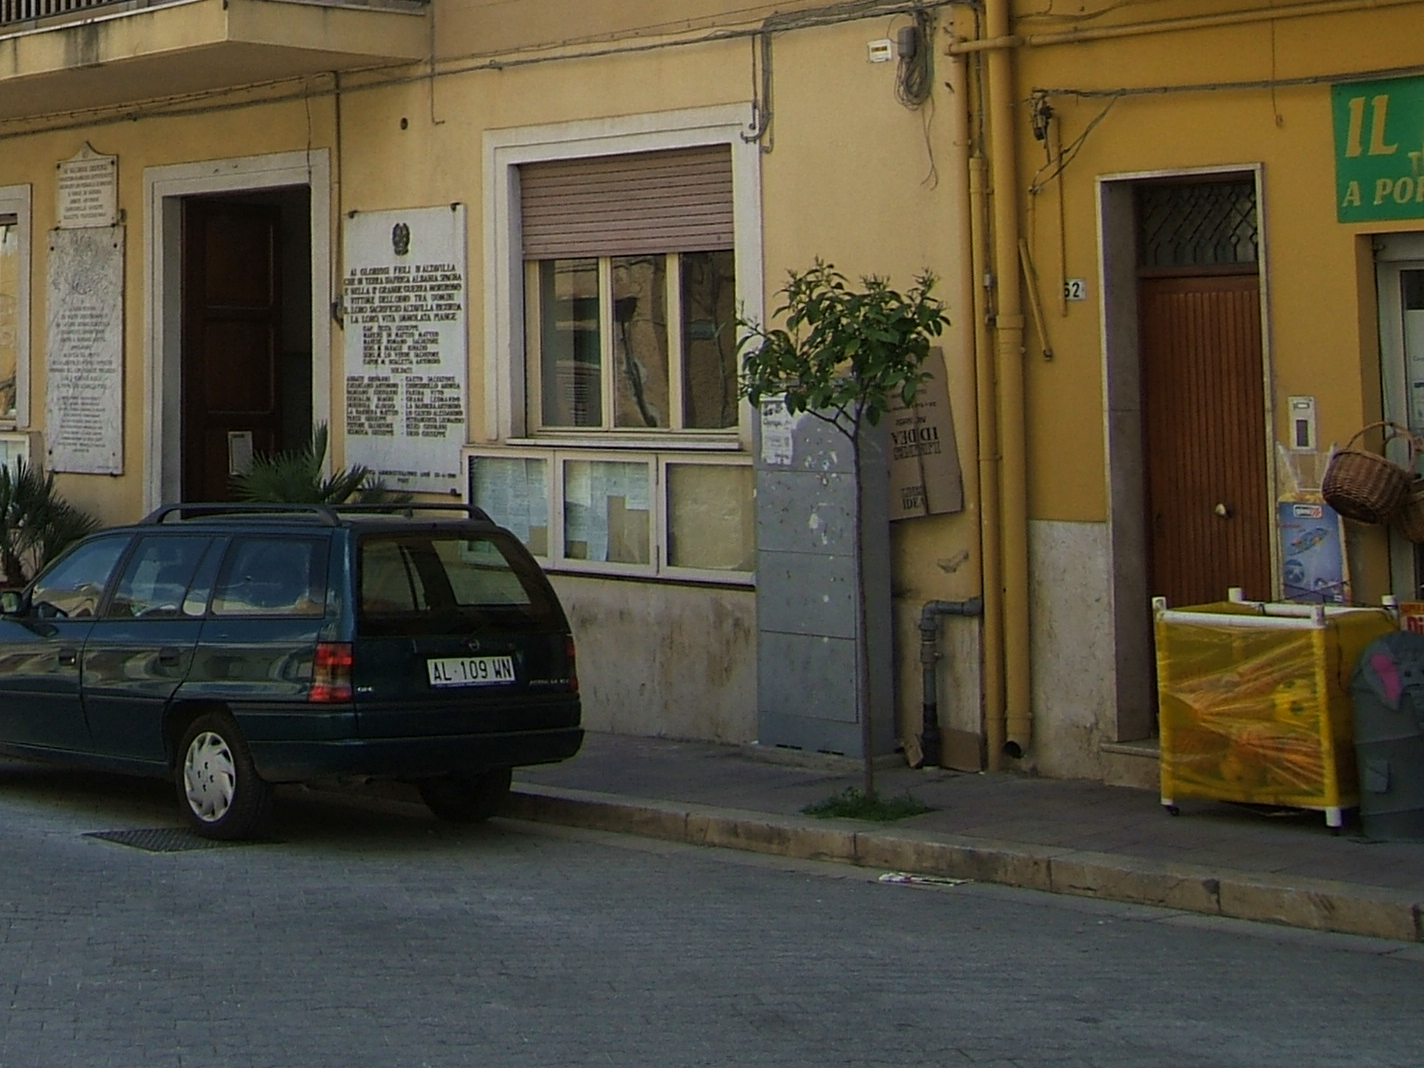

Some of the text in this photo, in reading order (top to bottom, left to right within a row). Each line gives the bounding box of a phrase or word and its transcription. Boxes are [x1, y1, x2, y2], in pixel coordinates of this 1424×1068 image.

[1345, 95, 1398, 157] IL
[1342, 180, 1361, 207] A
[433, 659, 512, 681] AL 109 WN
